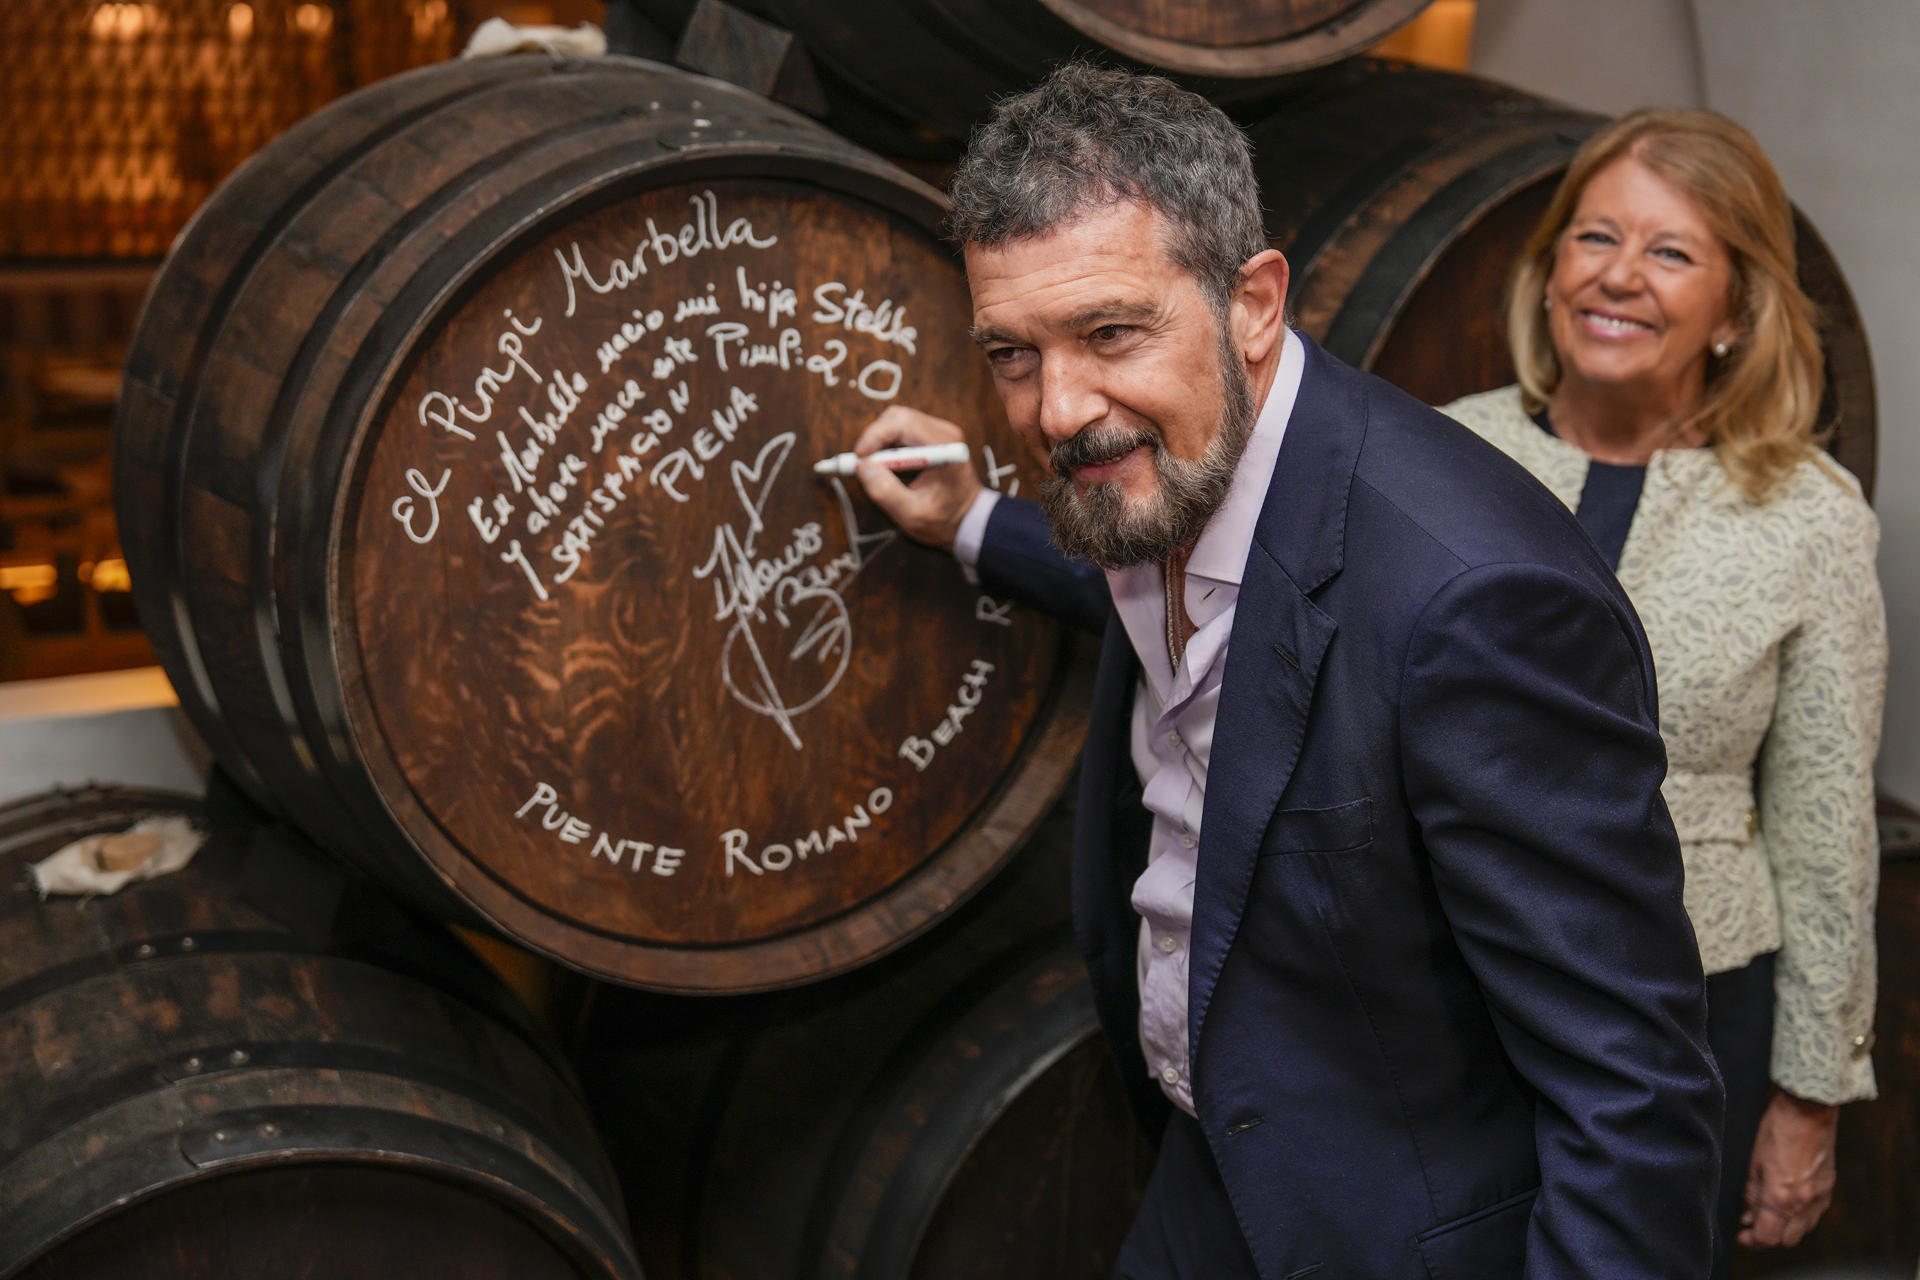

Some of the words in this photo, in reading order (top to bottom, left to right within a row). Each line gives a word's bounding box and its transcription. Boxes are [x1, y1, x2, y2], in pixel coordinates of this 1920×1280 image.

[553, 189, 777, 317] Marbella
[418, 309, 542, 440] Pimpi
[392, 468, 451, 543] El
[515, 782, 685, 876] PUENTE
